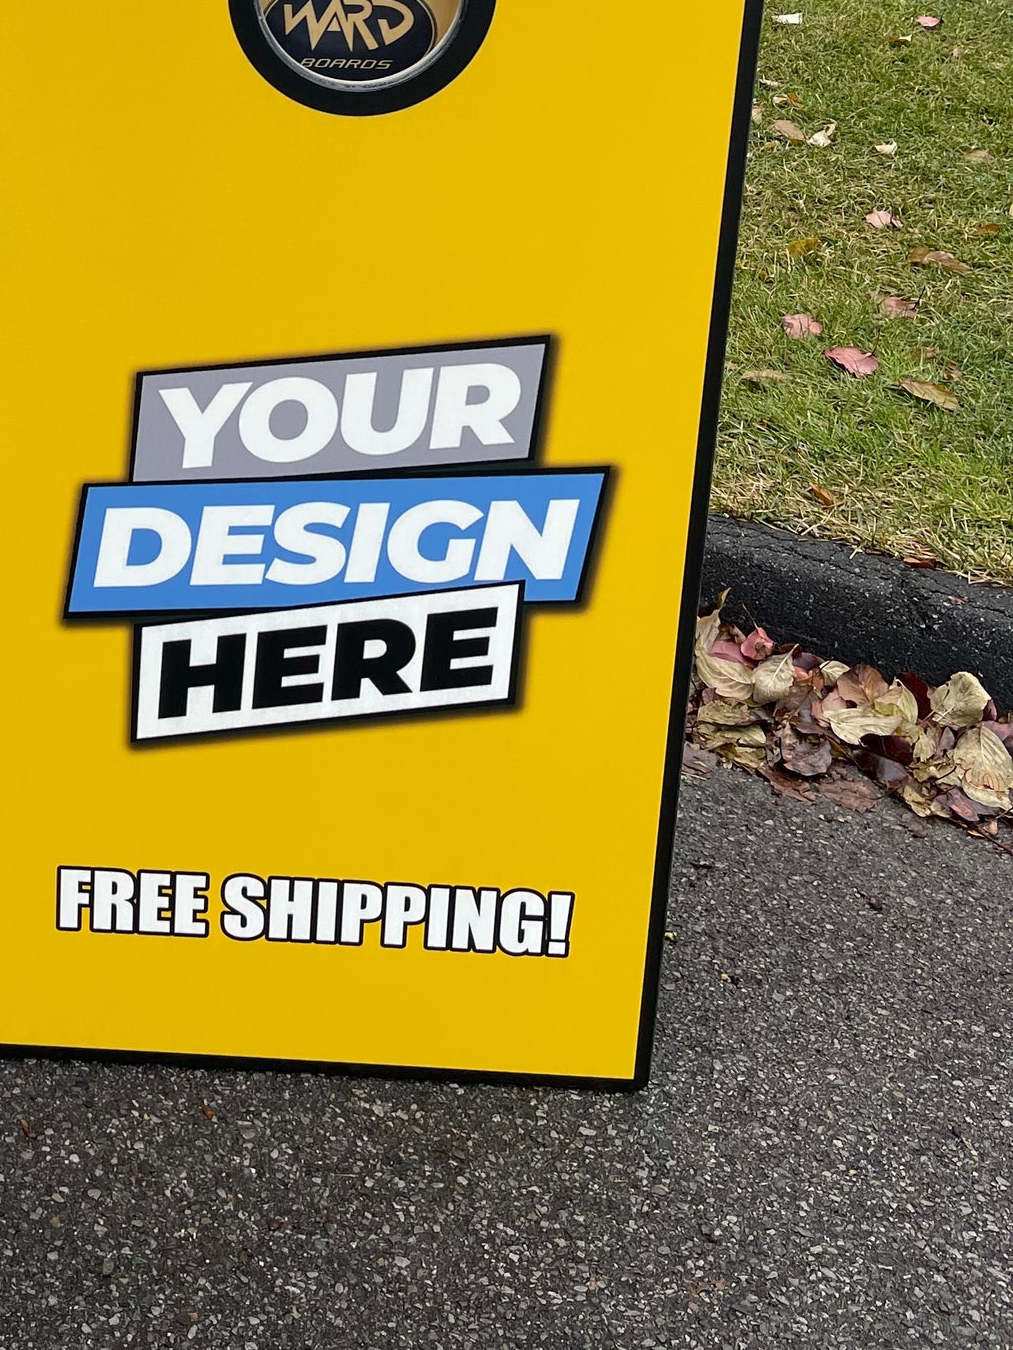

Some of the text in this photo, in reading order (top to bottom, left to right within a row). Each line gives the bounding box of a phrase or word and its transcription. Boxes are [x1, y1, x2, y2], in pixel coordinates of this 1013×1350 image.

[300, 57, 394, 71] BOARDS
[157, 361, 523, 470] YOUR
[92, 498, 582, 589] DESIGN
[157, 606, 500, 721] HERE
[56, 865, 577, 958] FREE SHIPPING!
